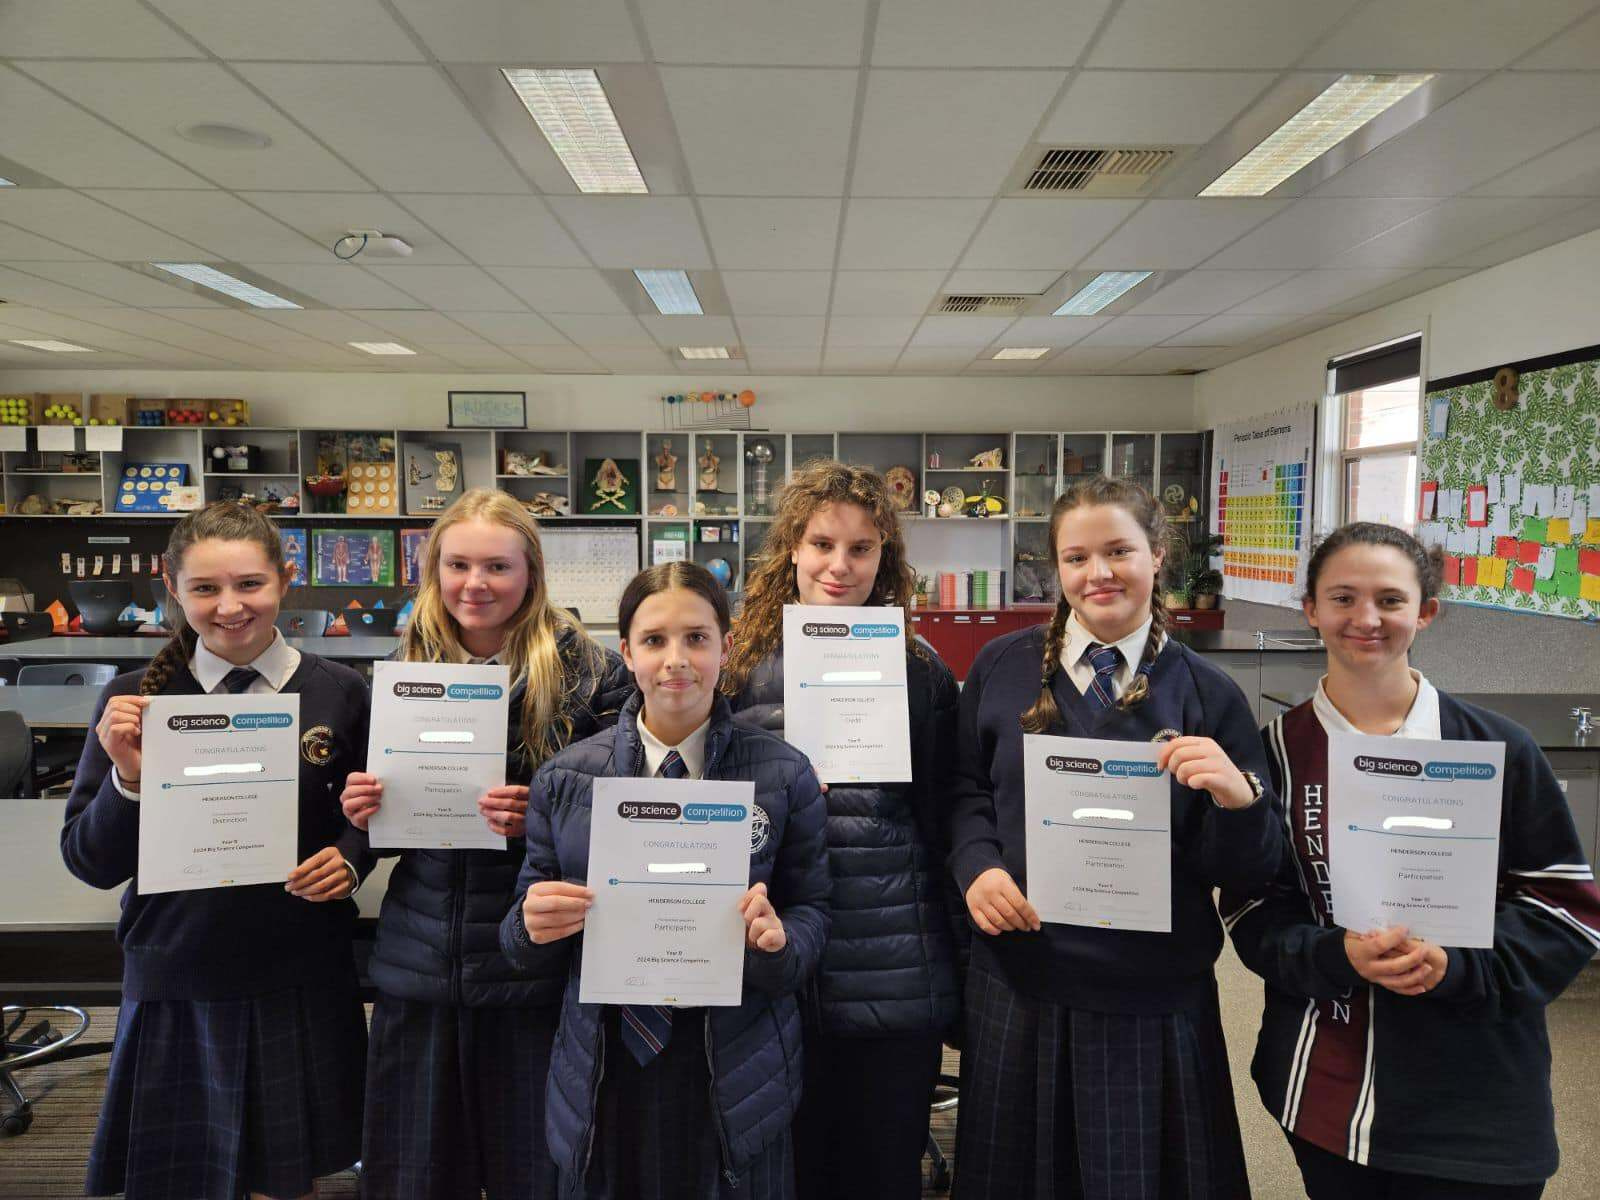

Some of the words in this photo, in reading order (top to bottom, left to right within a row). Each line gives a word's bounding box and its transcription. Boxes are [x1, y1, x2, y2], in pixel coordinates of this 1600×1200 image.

[806, 625, 817, 635] big
[820, 626, 846, 634] science
[854, 627, 896, 636] competition
[397, 684, 410, 695] big
[412, 685, 442, 695] science
[451, 687, 500, 697] competition
[173, 717, 188, 729] big
[191, 717, 226, 726] science
[236, 715, 289, 728] competition
[1050, 758, 1064, 769] big
[1066, 759, 1098, 770] science
[1107, 763, 1160, 774] competition
[1359, 758, 1375, 771] big
[1378, 761, 1418, 773] science
[1429, 766, 1492, 778] competition
[623, 804, 638, 816] big
[641, 805, 677, 816] science
[687, 807, 743, 819] competition
[655, 923, 697, 932] Participation
